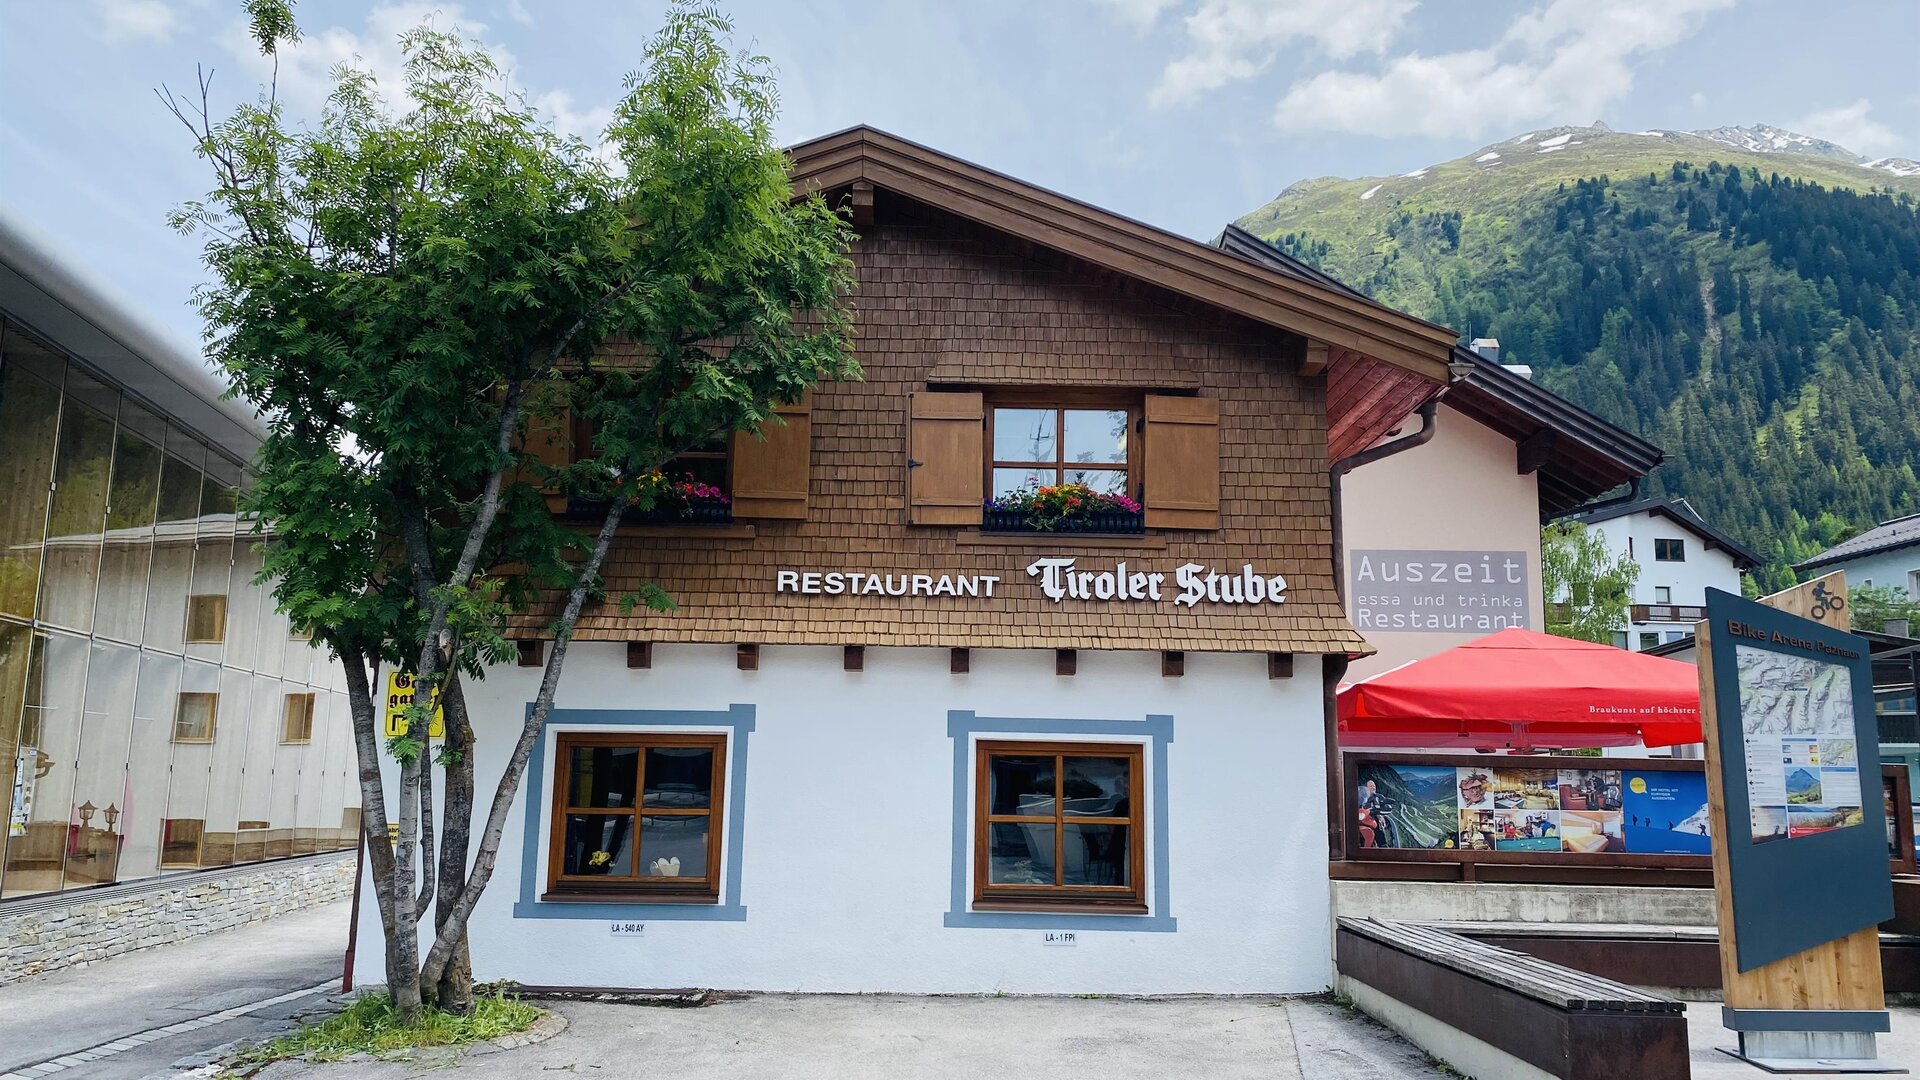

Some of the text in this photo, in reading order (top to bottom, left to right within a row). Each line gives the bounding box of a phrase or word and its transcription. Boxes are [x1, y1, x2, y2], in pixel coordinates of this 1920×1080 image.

[1357, 555, 1522, 584] Auszeit
[777, 557, 1288, 607] RESTAURANT Tiroler Stube
[1358, 593, 1523, 607] essa und trinka
[1358, 608, 1523, 629] Restaurant
[1728, 619, 1861, 659] Bike Arena Paznaun
[1589, 705, 1697, 714] Braukunst auf höchster
[1045, 933, 1054, 941] LA
